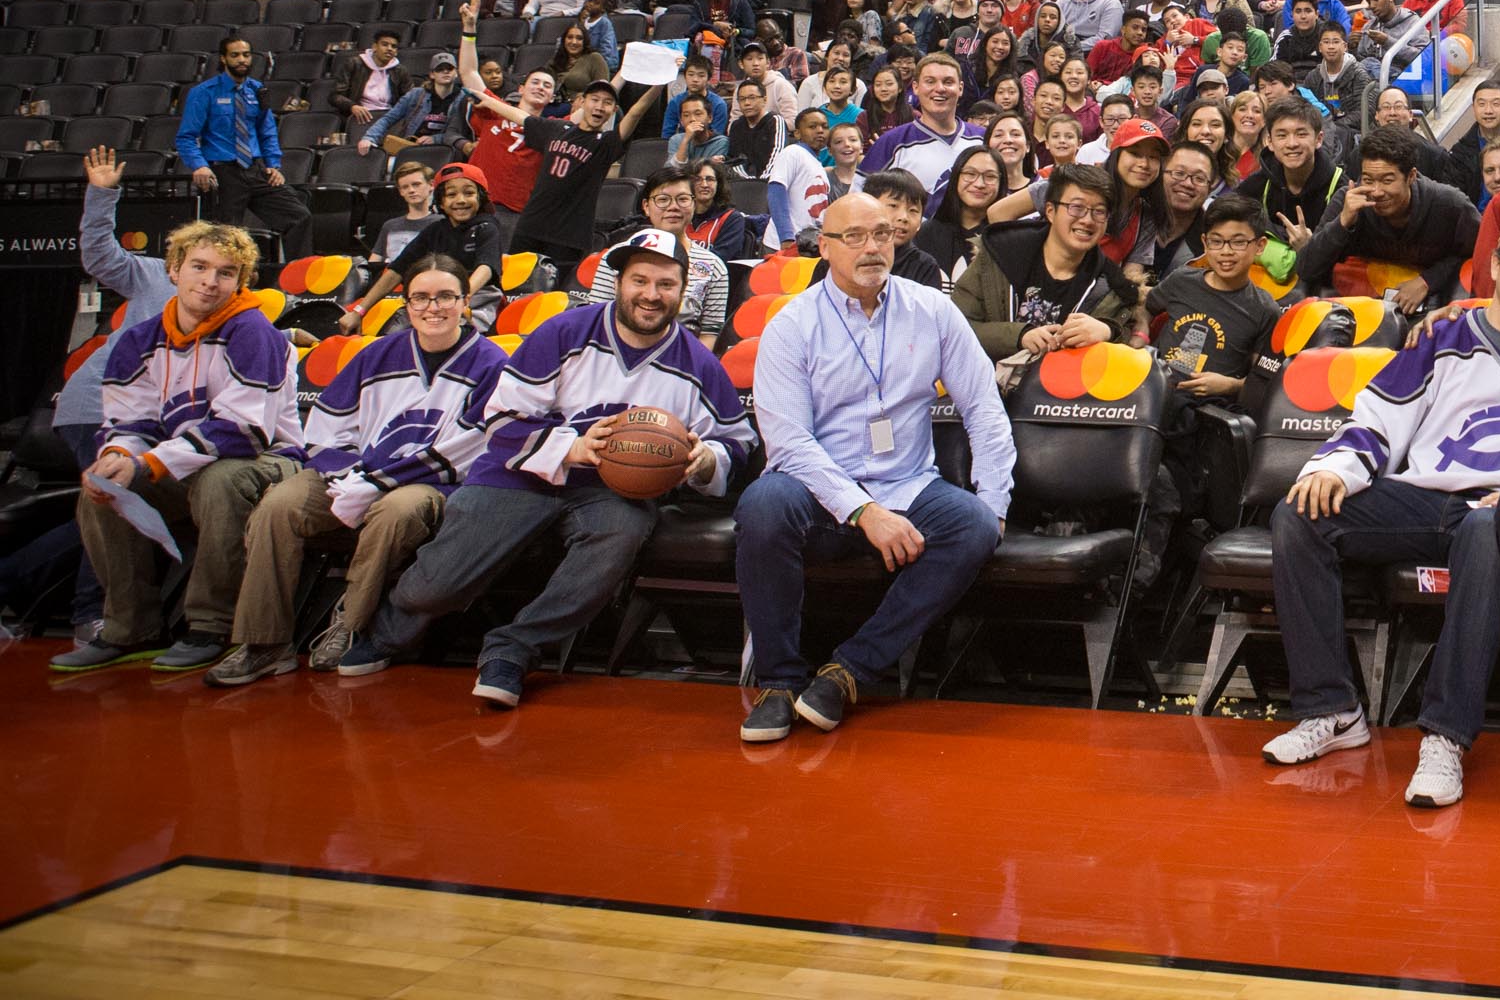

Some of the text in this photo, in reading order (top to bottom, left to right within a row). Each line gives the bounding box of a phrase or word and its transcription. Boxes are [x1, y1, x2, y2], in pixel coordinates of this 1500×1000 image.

[507, 132, 525, 153] 7
[550, 156, 571, 178] 10
[11, 237, 77, 252] ALWAYS
[1207, 318, 1226, 350] GRATE
[628, 411, 659, 424] NBA
[609, 439, 675, 459] SPALDING
